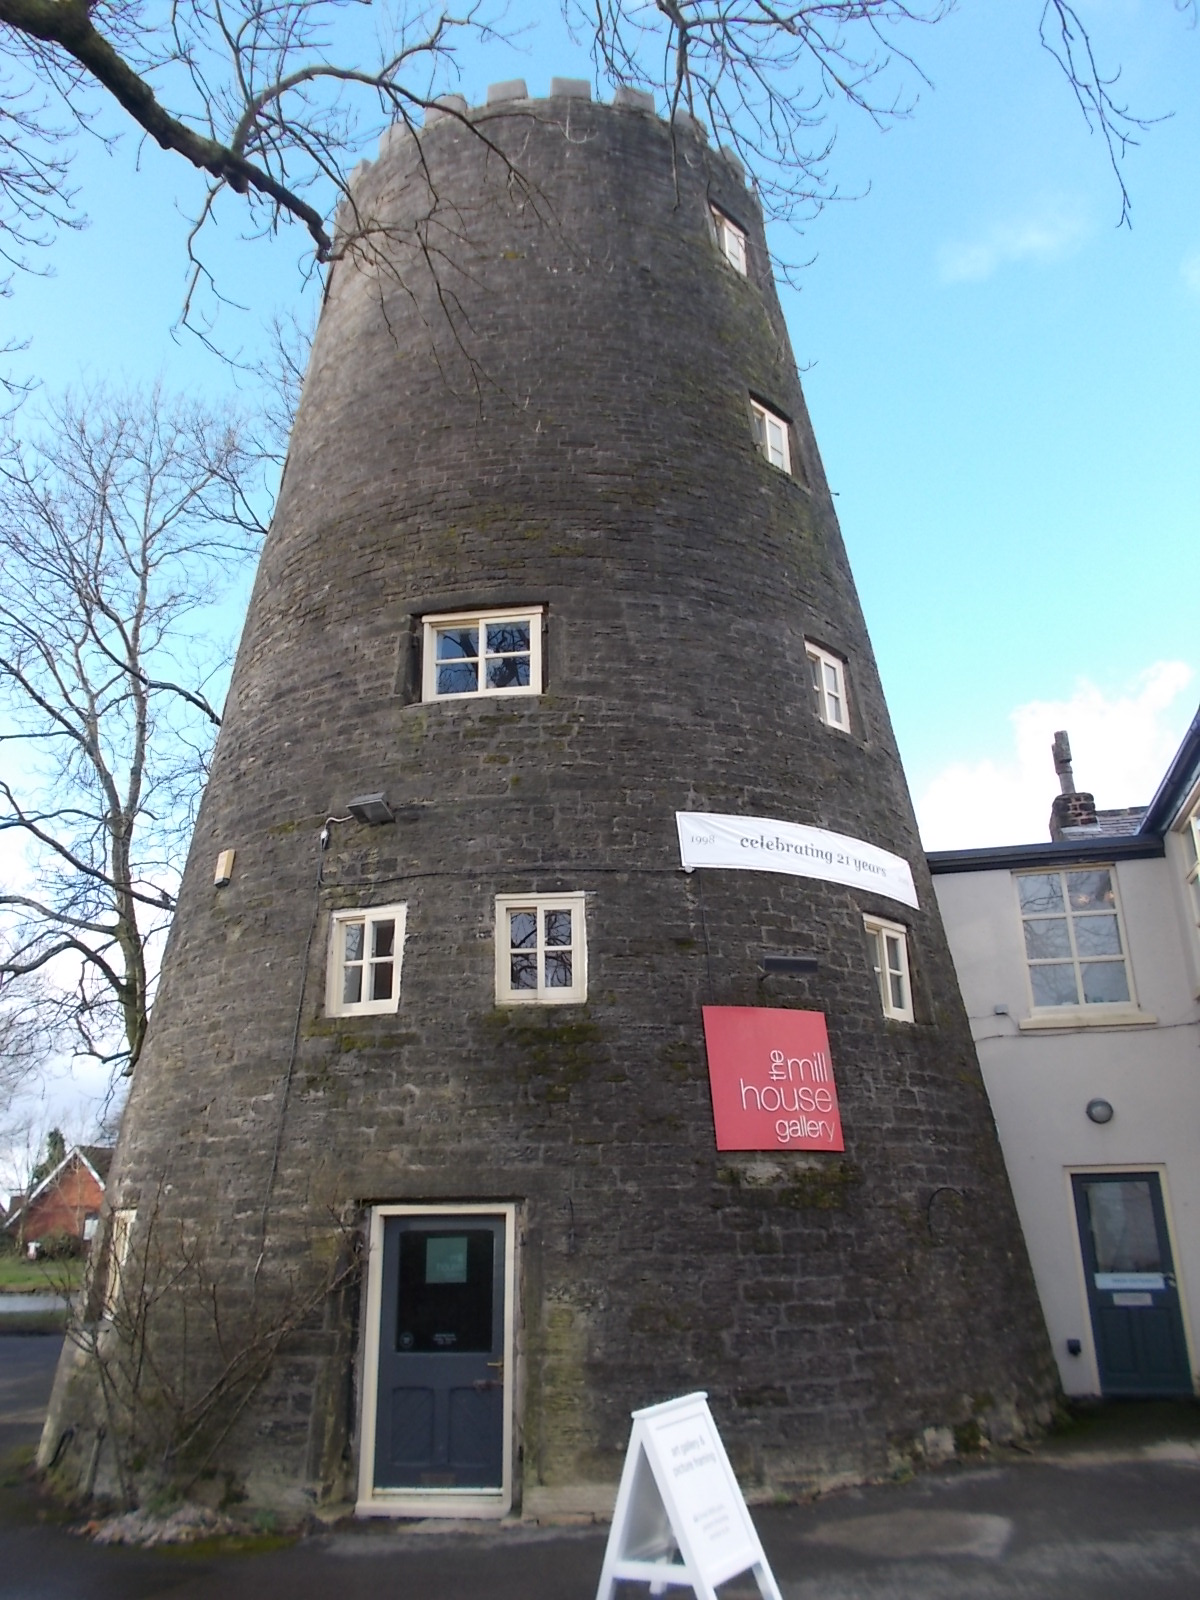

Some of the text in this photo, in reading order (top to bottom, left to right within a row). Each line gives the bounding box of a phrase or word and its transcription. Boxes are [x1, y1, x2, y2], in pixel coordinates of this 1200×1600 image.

[690, 834, 887, 878] 1998 celebrating 21 years
[768, 1050, 828, 1083] the mill
[740, 1078, 832, 1113] house
[776, 1115, 835, 1143] gallery
